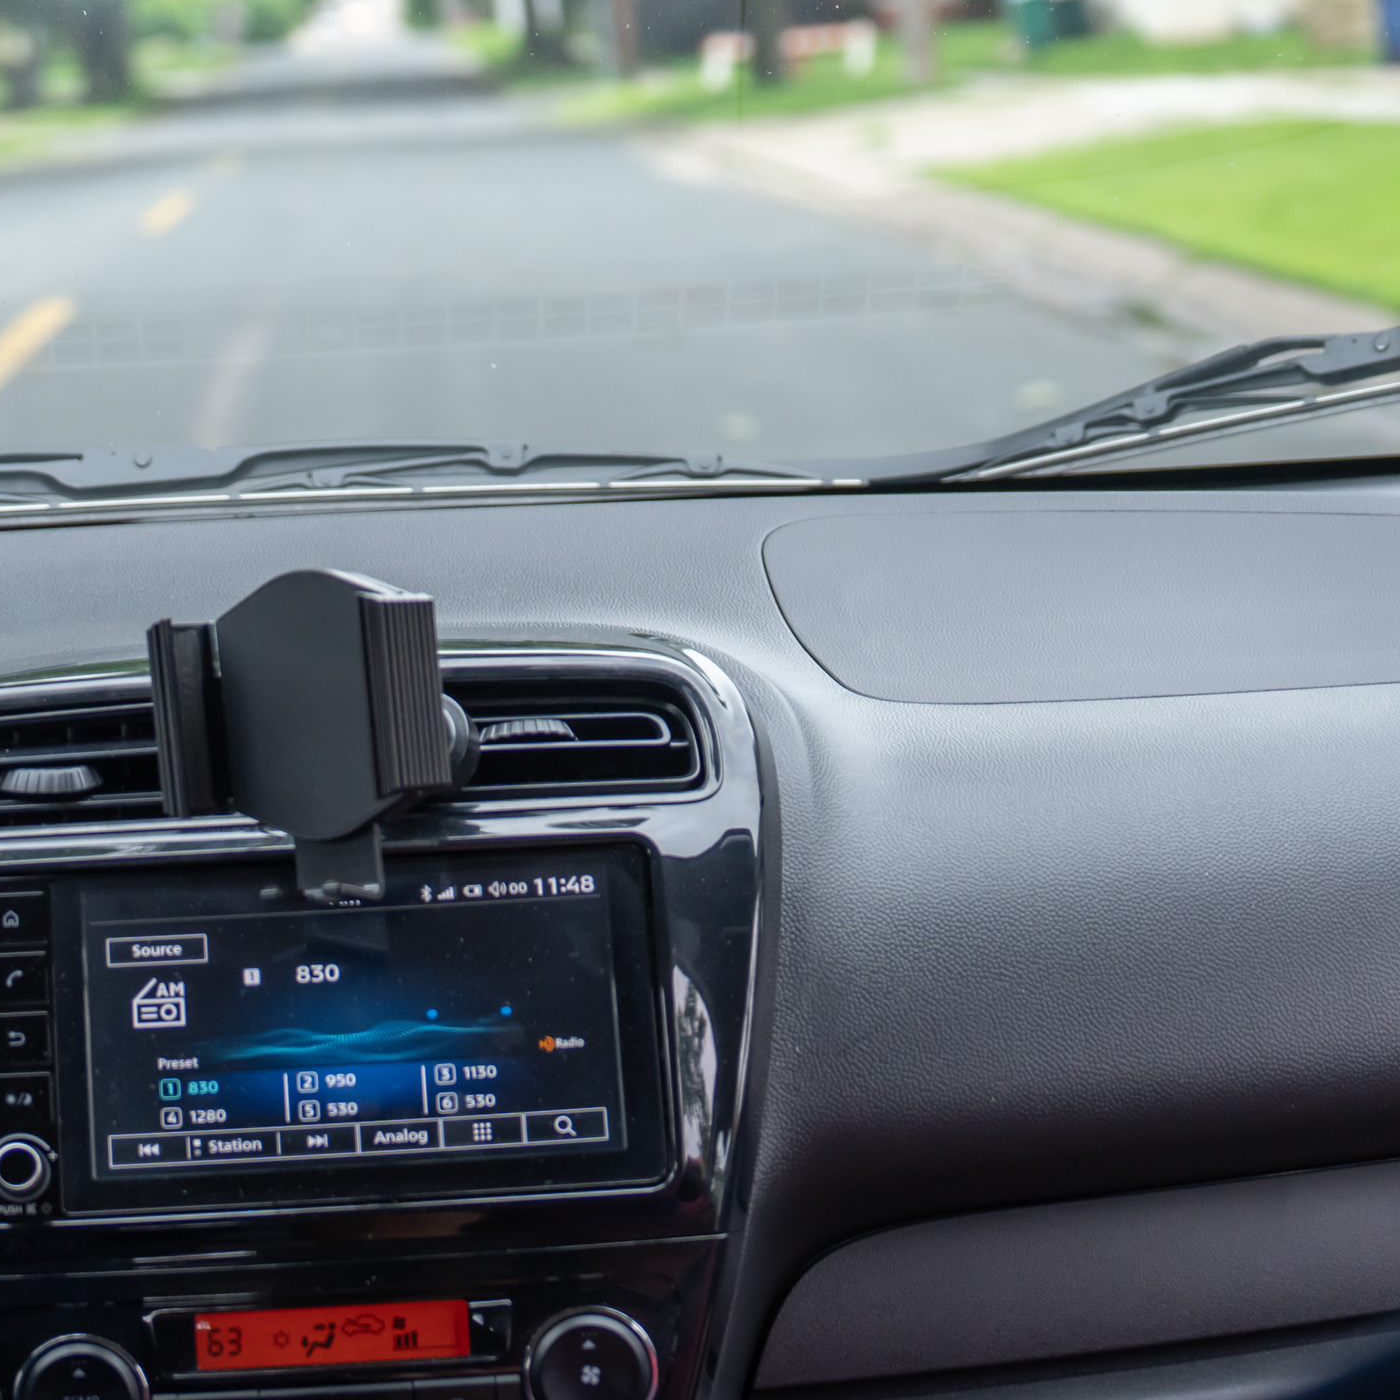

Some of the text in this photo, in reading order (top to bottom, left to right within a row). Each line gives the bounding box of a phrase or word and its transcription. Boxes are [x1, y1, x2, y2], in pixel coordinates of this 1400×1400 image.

[533, 875, 595, 896] 11:48
[131, 943, 183, 959] Source
[295, 963, 340, 984] 830
[156, 981, 185, 998] AM
[555, 1036, 585, 1049] Radio
[157, 1056, 199, 1070] Preset
[462, 1064, 498, 1080] 1130
[187, 1081, 219, 1095] 830
[324, 1073, 356, 1088] 950
[465, 1094, 497, 1108] 530
[188, 1109, 227, 1124] 1280
[327, 1102, 358, 1117] 530
[373, 1128, 429, 1145] Analog
[208, 1138, 262, 1154] Station
[207, 1327, 243, 1357] 63
